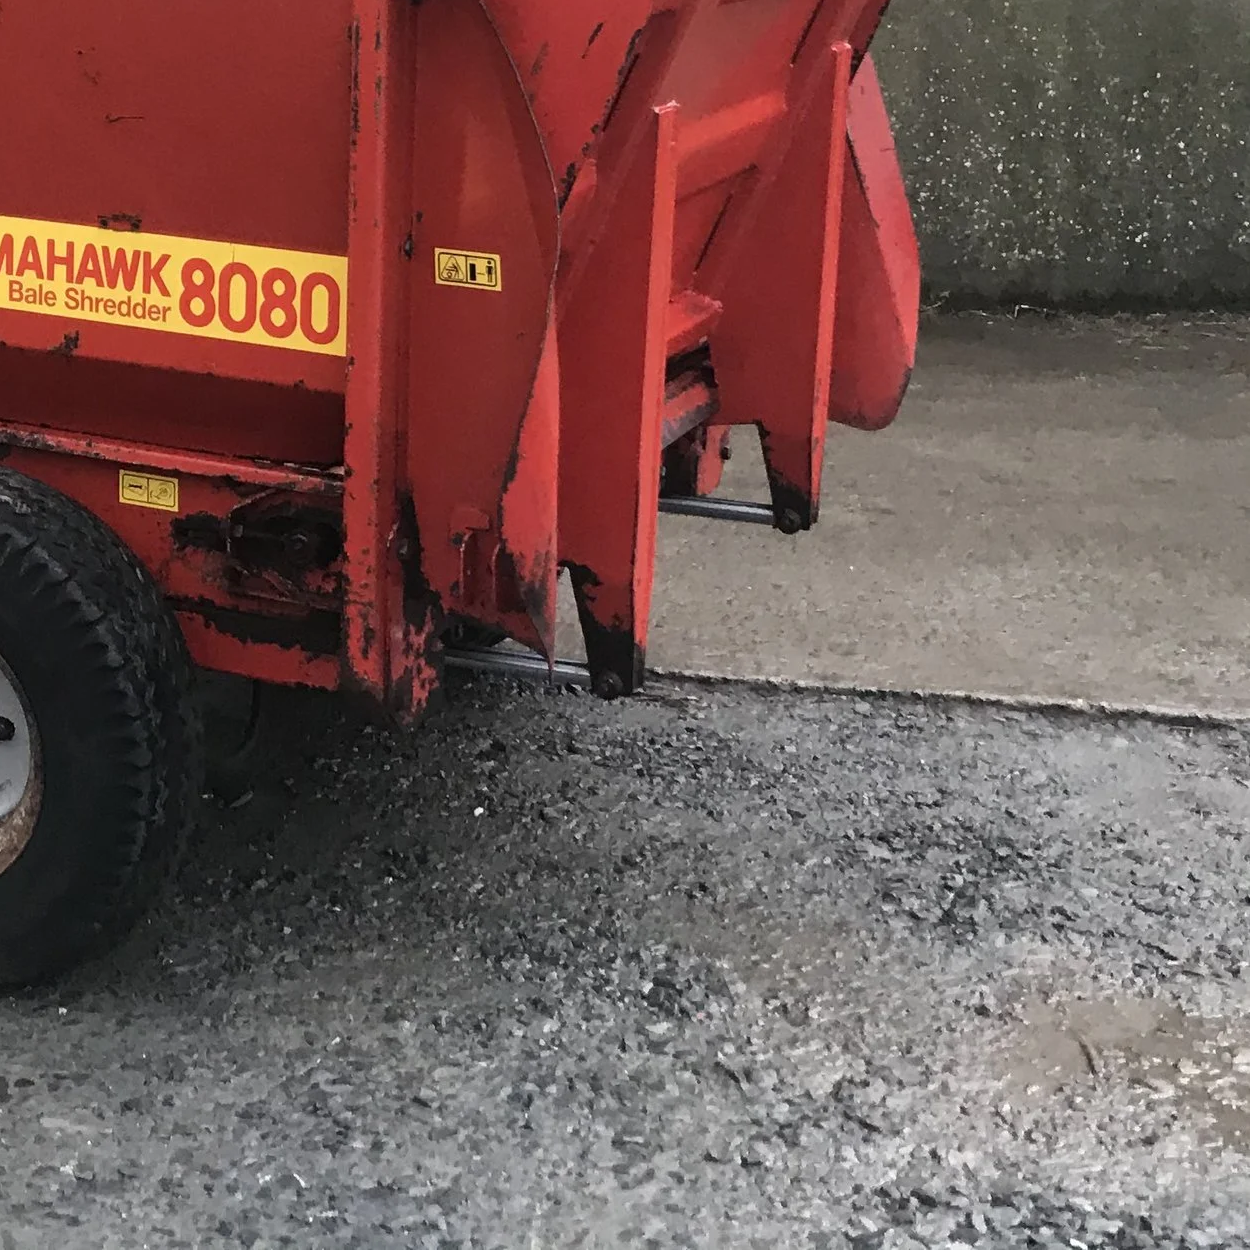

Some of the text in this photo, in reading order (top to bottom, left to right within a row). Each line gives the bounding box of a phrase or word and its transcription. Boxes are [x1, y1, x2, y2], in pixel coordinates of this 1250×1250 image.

[8, 279, 172, 323] Bale Shredder
[179, 257, 341, 346] 8080
